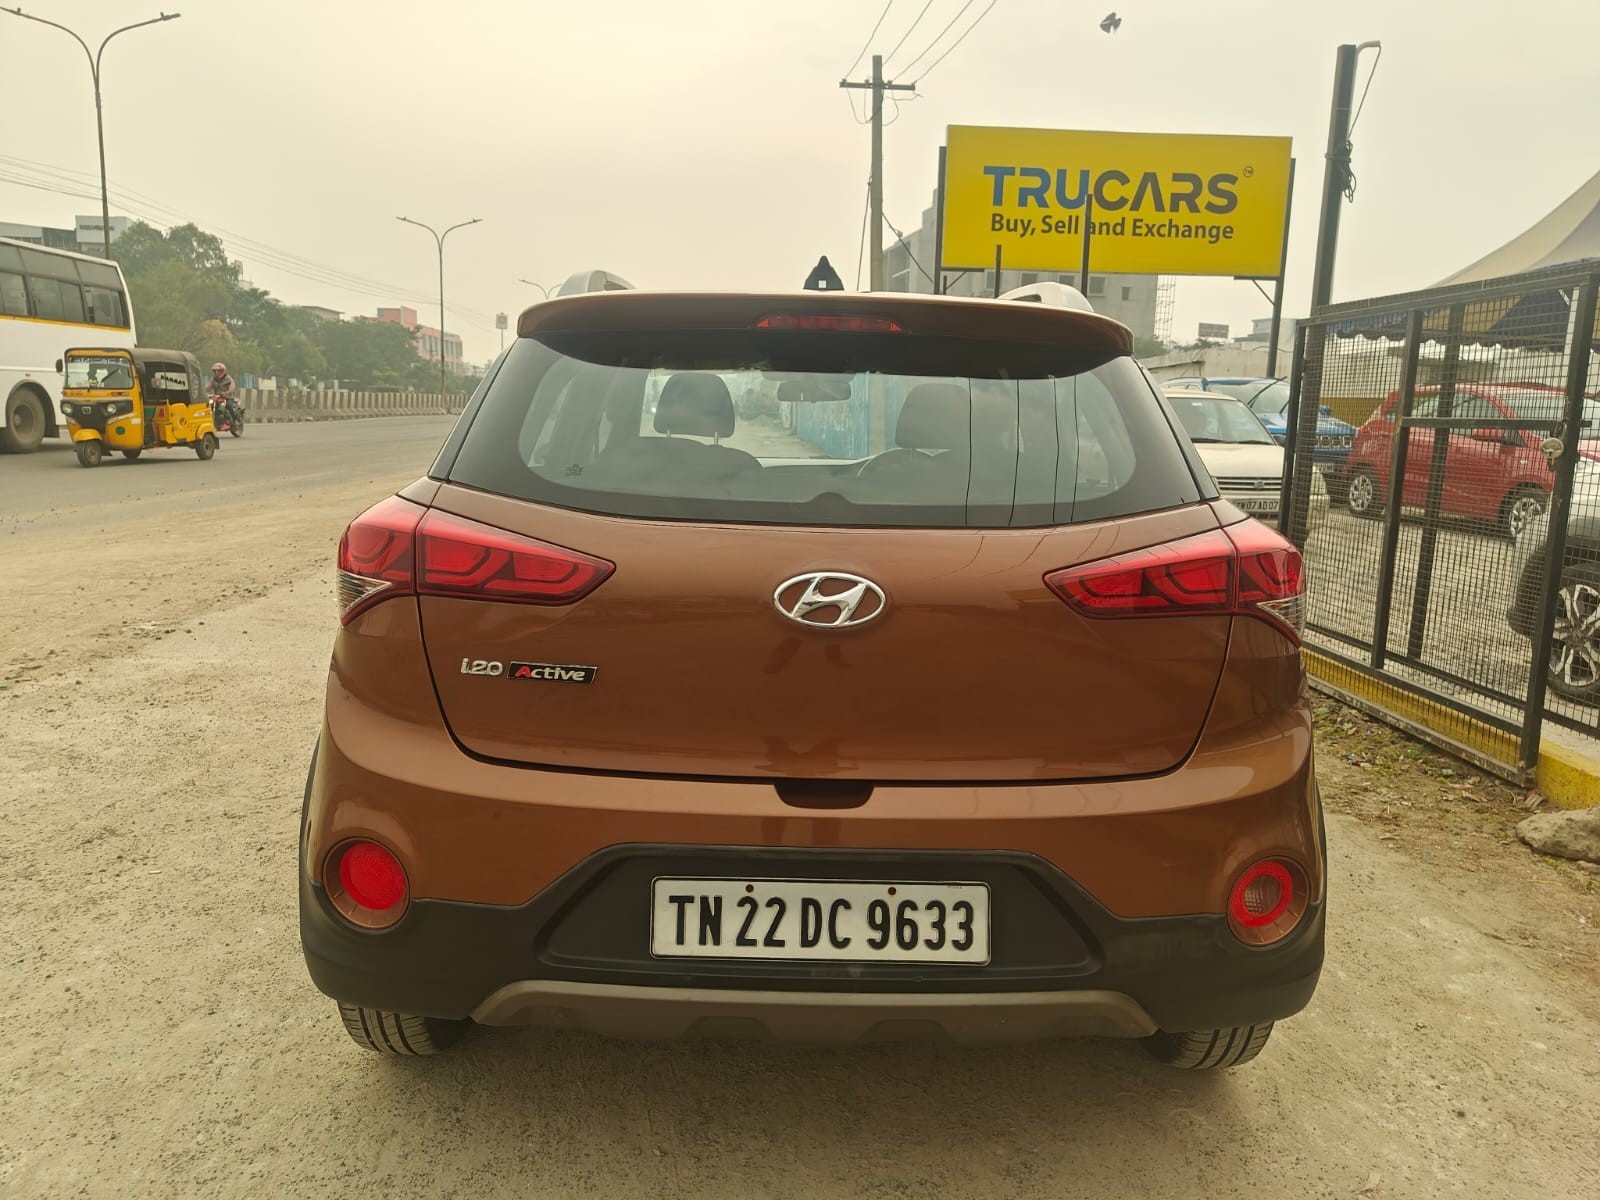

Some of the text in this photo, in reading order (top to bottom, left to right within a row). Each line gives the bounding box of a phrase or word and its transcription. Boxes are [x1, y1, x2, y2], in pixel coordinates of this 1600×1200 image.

[983, 165, 1239, 214] TRUCARS
[991, 213, 1234, 244] Buy, Sell and Exchange
[514, 665, 586, 681] Active
[669, 895, 975, 951] TN 22 DC 9633
